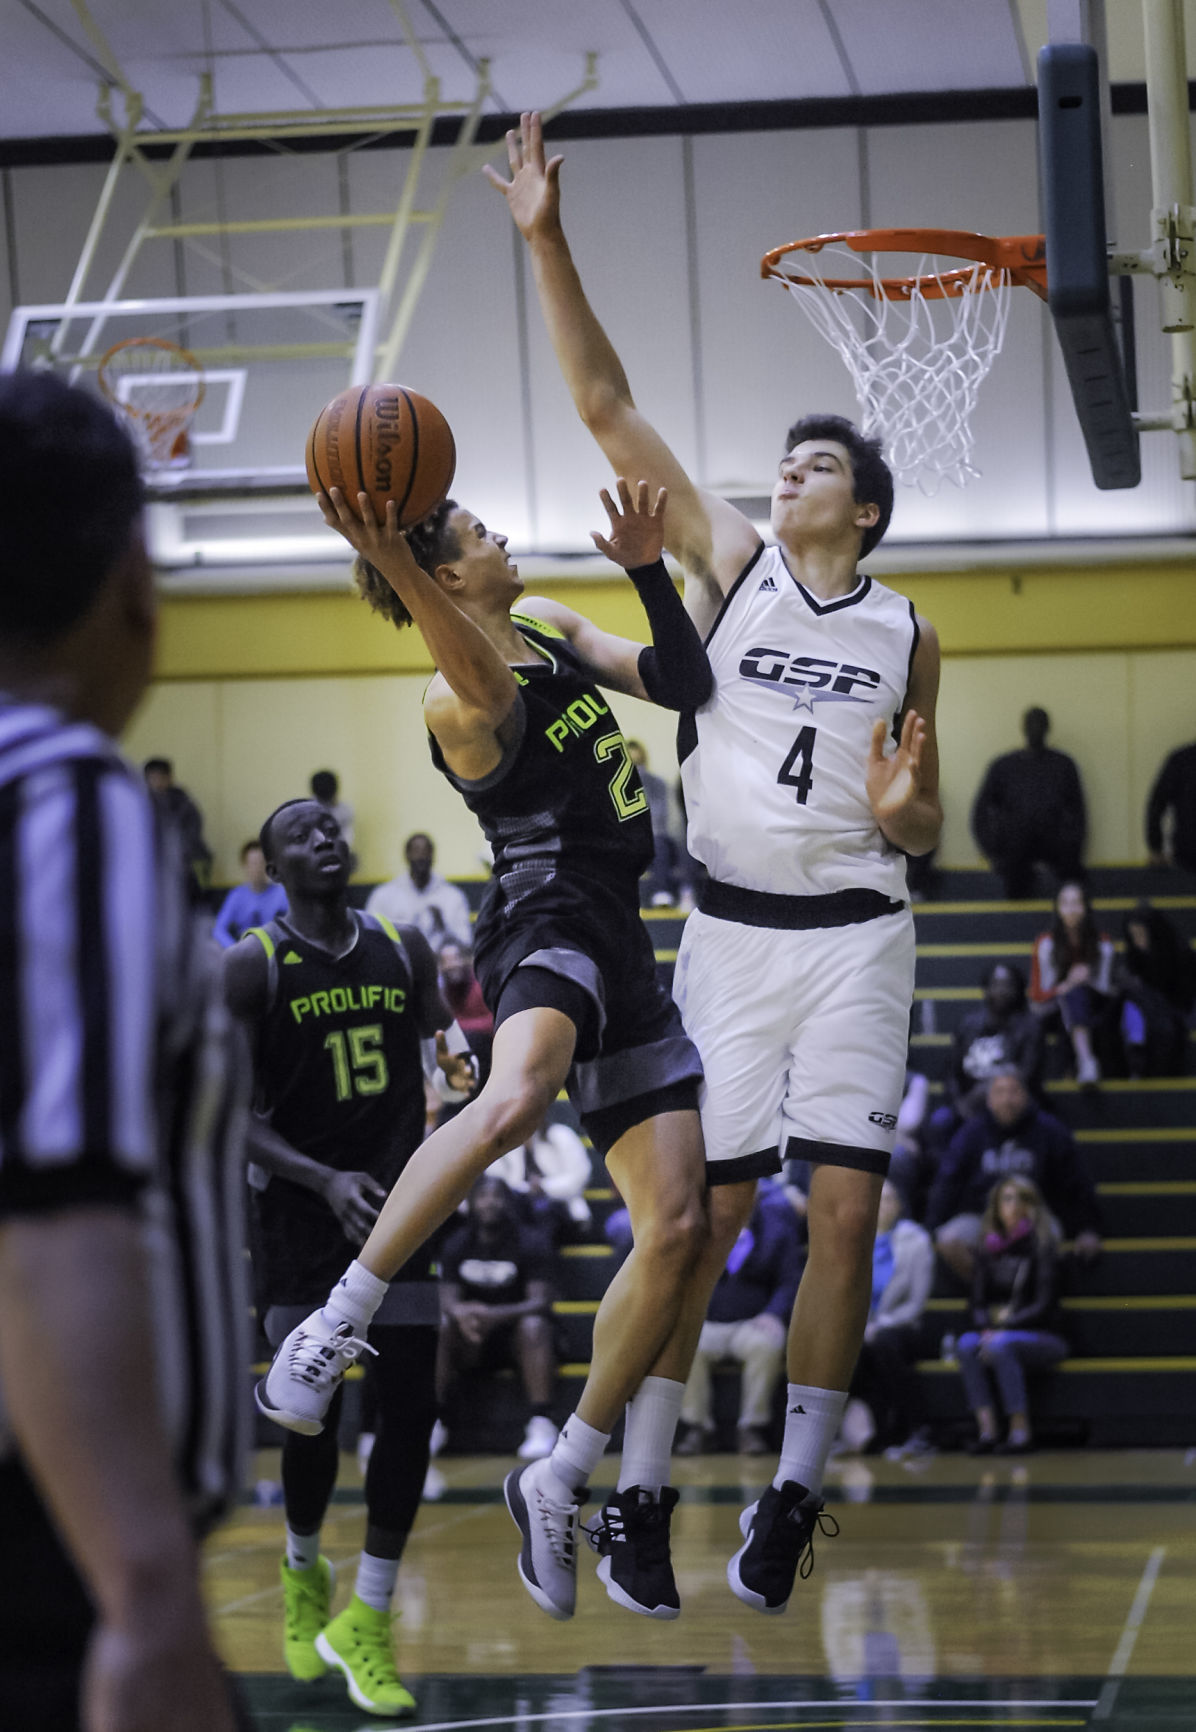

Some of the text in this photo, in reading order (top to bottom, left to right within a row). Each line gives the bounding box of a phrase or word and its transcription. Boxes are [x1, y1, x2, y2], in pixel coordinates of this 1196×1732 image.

[375, 397, 400, 491] Wilson
[739, 647, 881, 694] GSP
[593, 730, 649, 823] 2
[777, 726, 817, 805] 4
[290, 984, 406, 1024] PROLIFIC
[324, 1024, 389, 1102] 15
